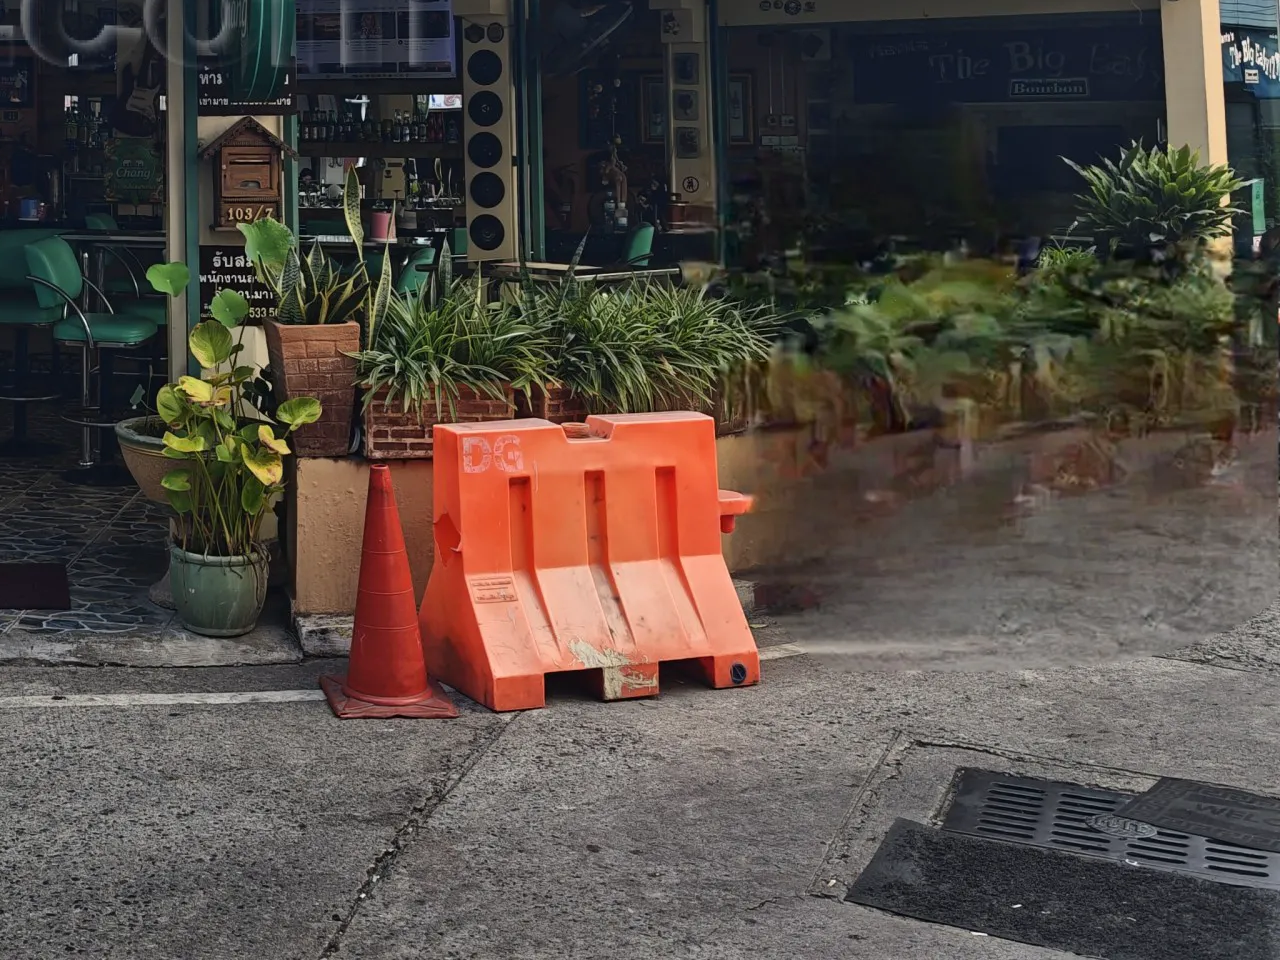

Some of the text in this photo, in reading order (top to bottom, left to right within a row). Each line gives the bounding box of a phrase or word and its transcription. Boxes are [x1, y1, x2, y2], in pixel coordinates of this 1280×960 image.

[1012, 82, 1084, 95] Bourbon
[116, 167, 151, 180] Chang
[462, 435, 524, 473] DG
